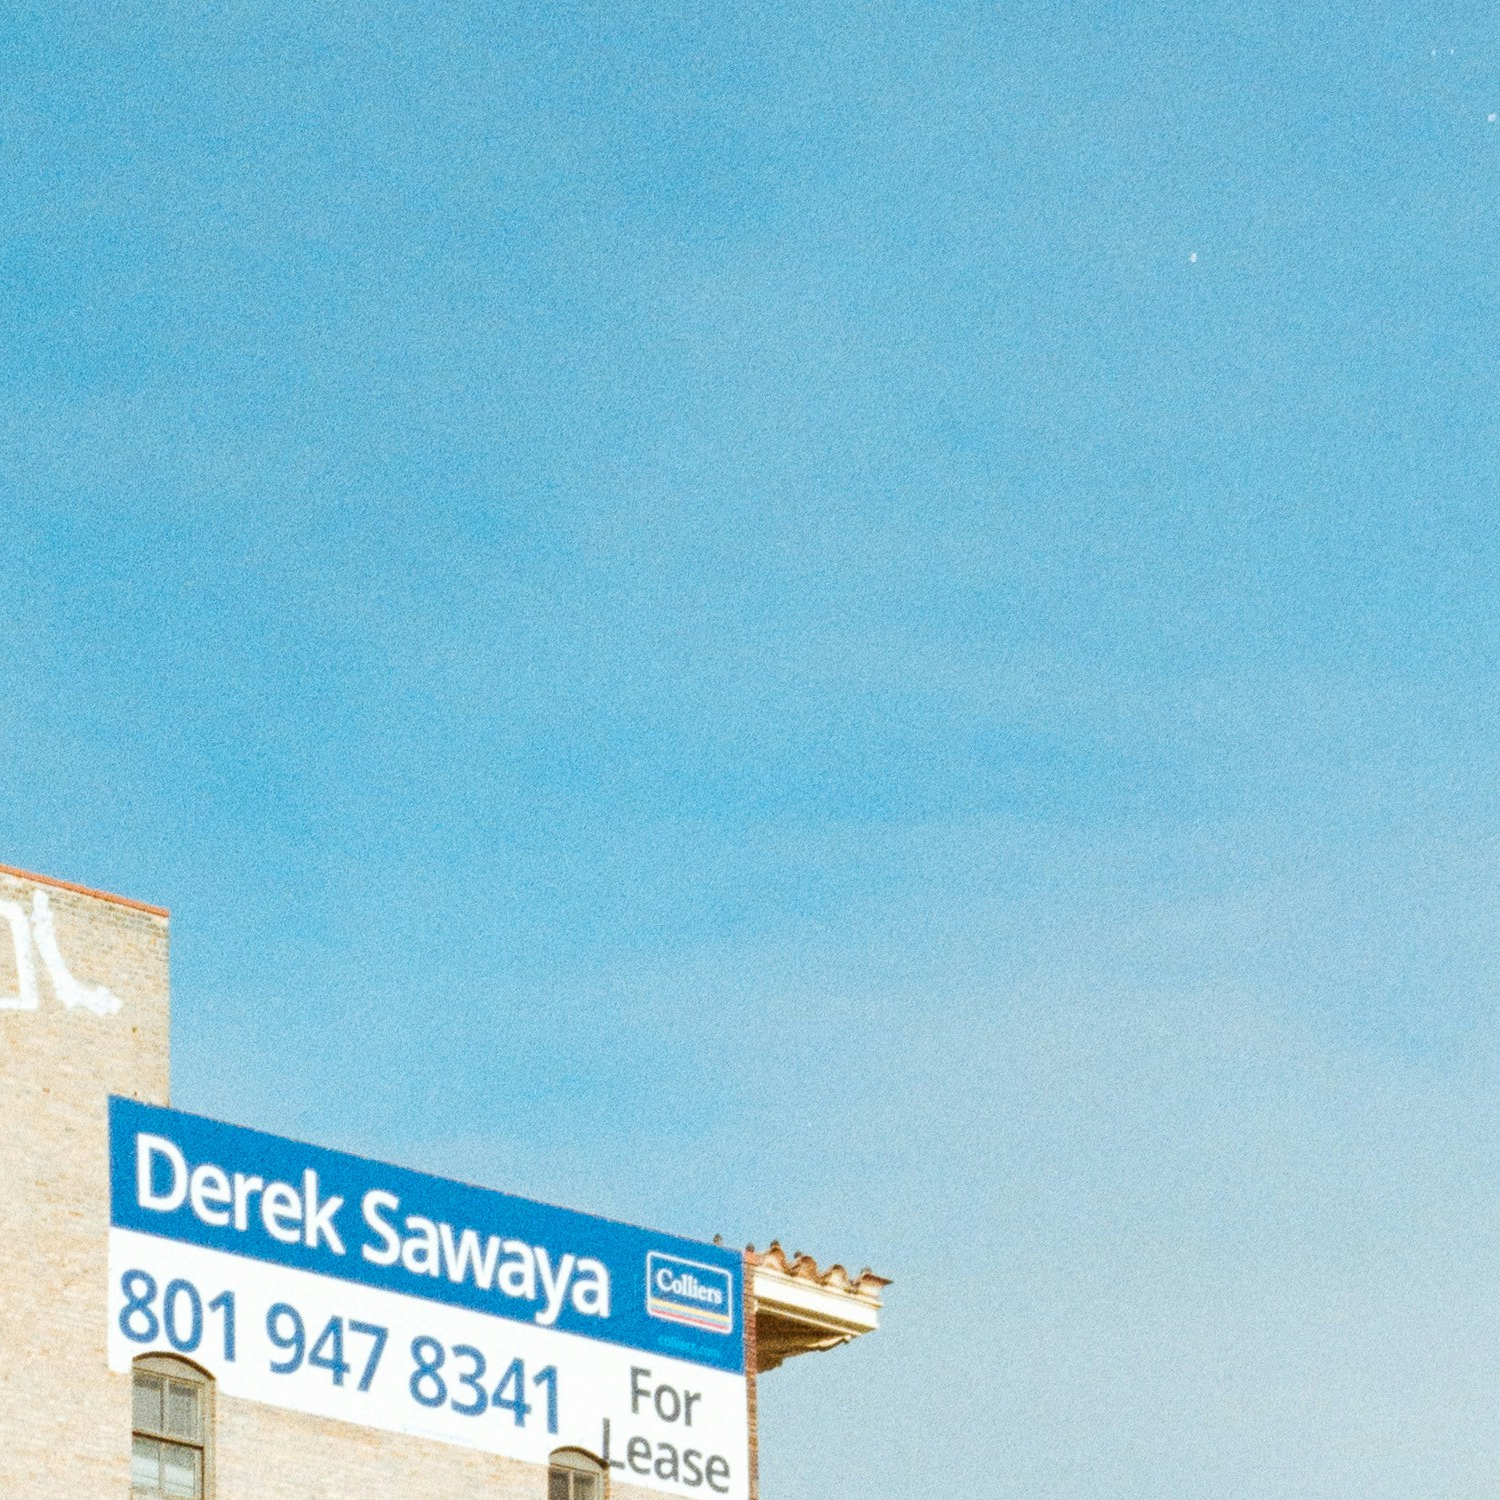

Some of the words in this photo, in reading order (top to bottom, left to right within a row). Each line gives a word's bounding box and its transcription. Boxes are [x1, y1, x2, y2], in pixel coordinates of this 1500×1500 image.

[136, 1132, 346, 1255] Derek
[361, 1190, 610, 1325] Sawaya
[656, 1268, 722, 1304] Colliers
[118, 1269, 236, 1363] 801
[266, 1303, 389, 1392] 947
[408, 1335, 559, 1435] 8341
[631, 1366, 702, 1427] For
[602, 1417, 730, 1494] Lease
